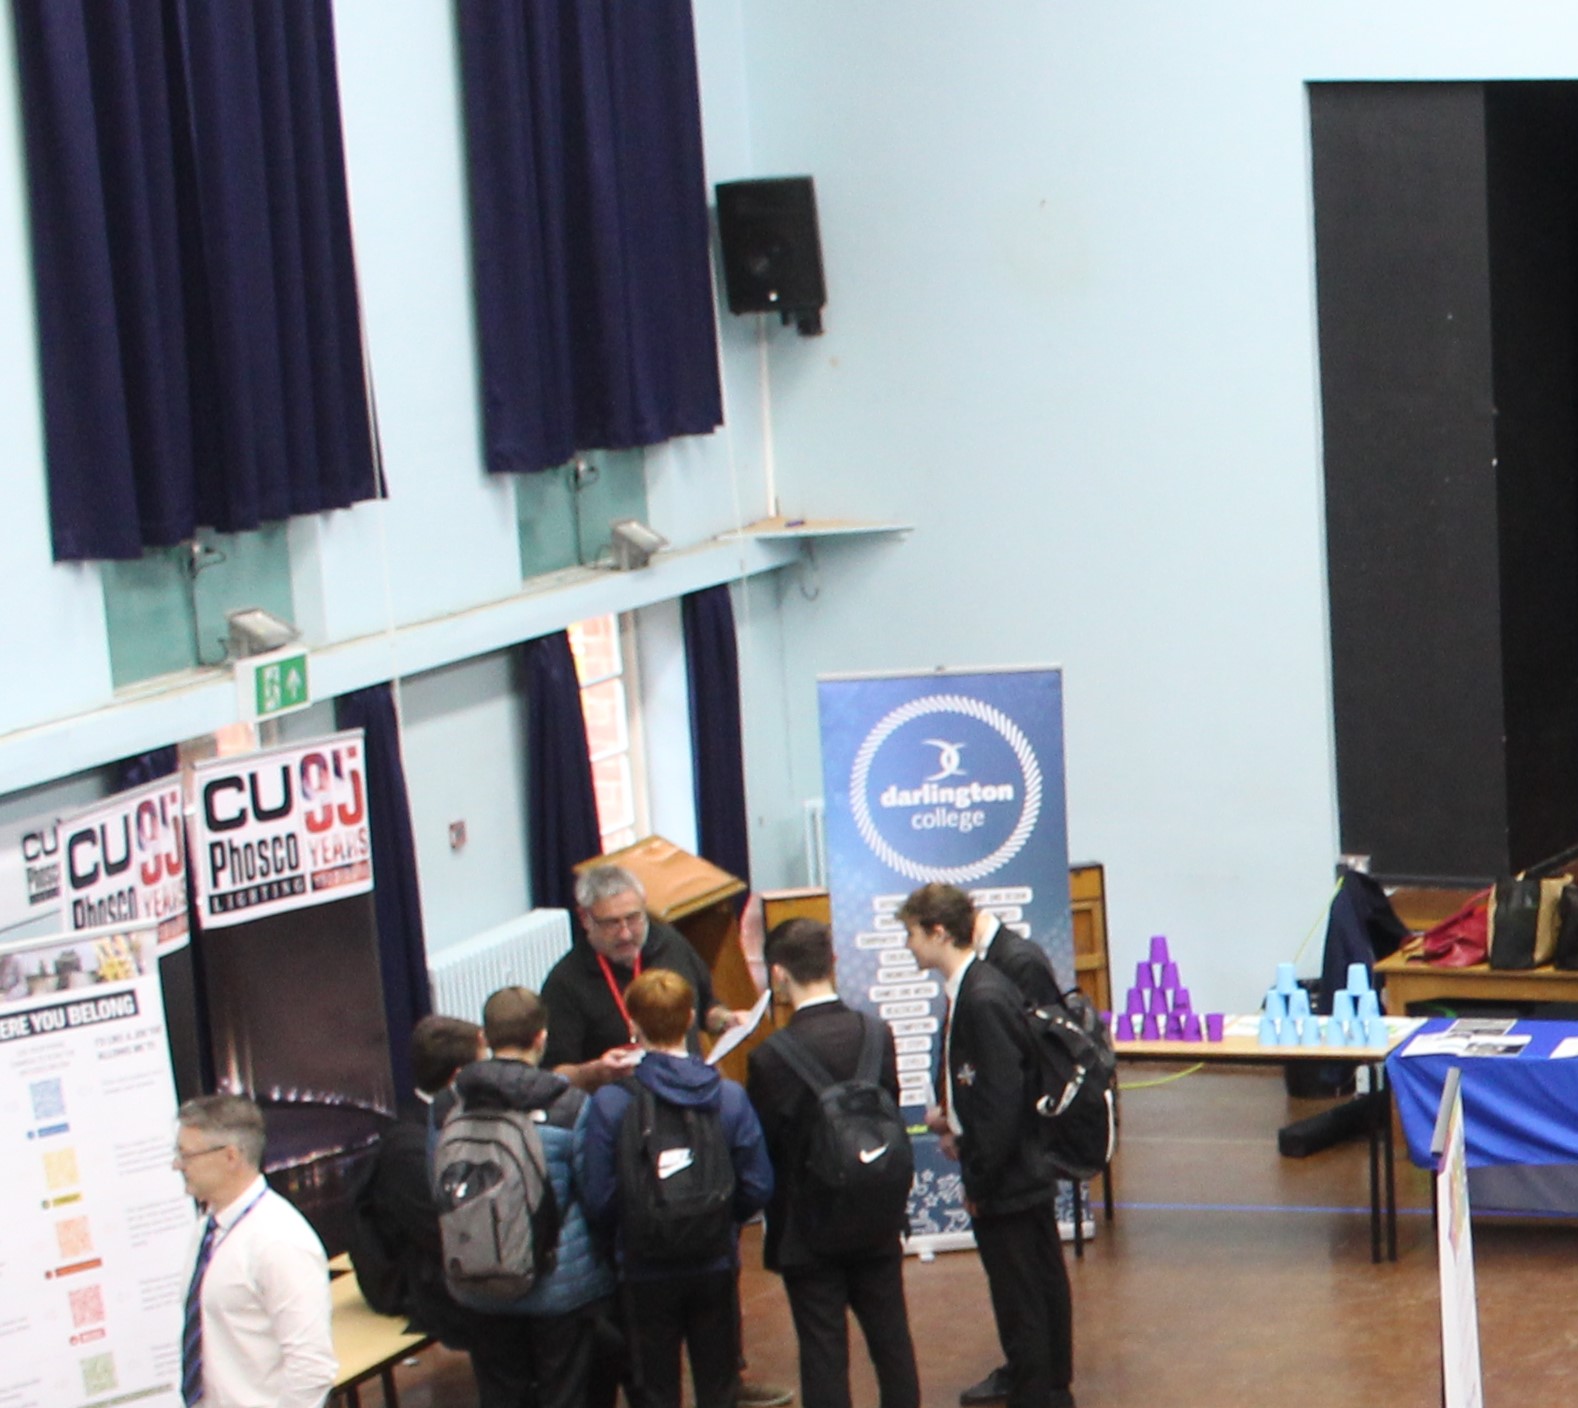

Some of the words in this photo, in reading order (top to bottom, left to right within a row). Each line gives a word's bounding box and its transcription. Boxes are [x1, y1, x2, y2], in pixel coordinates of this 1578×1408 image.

[203, 765, 293, 833] CU
[300, 746, 364, 833] 95
[880, 782, 1014, 809] darlington
[911, 807, 986, 832] college
[69, 813, 131, 890] CU
[209, 832, 299, 889] Phosco
[30, 1007, 66, 1033] YOU
[67, 994, 136, 1026] BELONG
